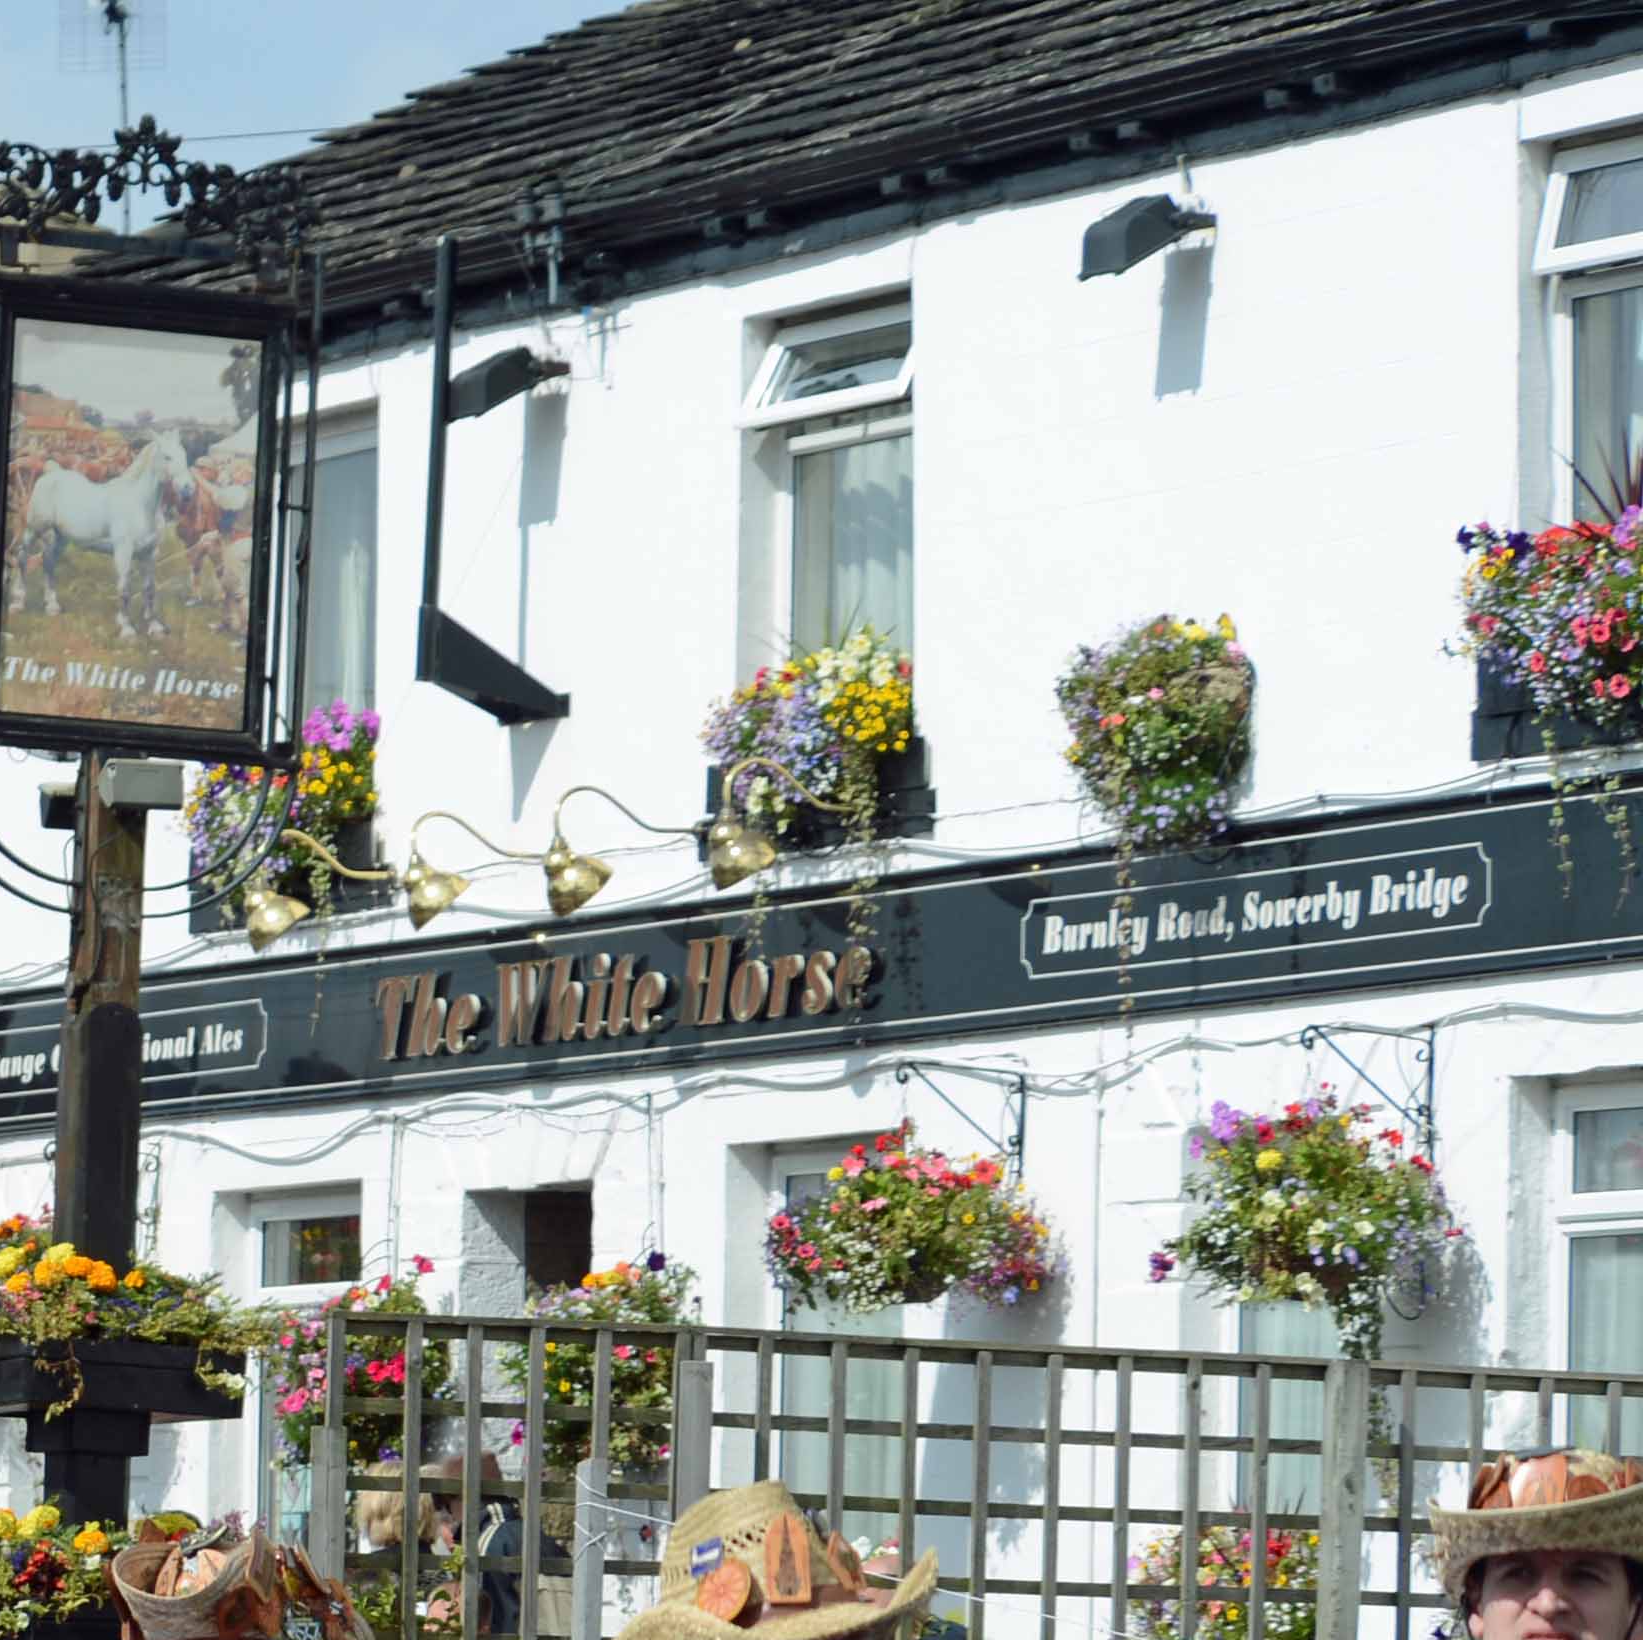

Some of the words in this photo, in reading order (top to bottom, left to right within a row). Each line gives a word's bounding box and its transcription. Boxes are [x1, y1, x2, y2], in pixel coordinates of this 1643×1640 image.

[3, 655, 57, 684] The
[65, 660, 146, 691] White
[153, 668, 239, 699] Horse
[1041, 909, 1149, 956] Burnley
[1156, 897, 1234, 943] Road,
[1242, 879, 1361, 932] Sowerby
[1369, 866, 1470, 918] Bridge
[377, 969, 483, 1062] The
[497, 952, 669, 1048] White
[677, 934, 874, 1027] Horse
[198, 1023, 243, 1056] Ales
